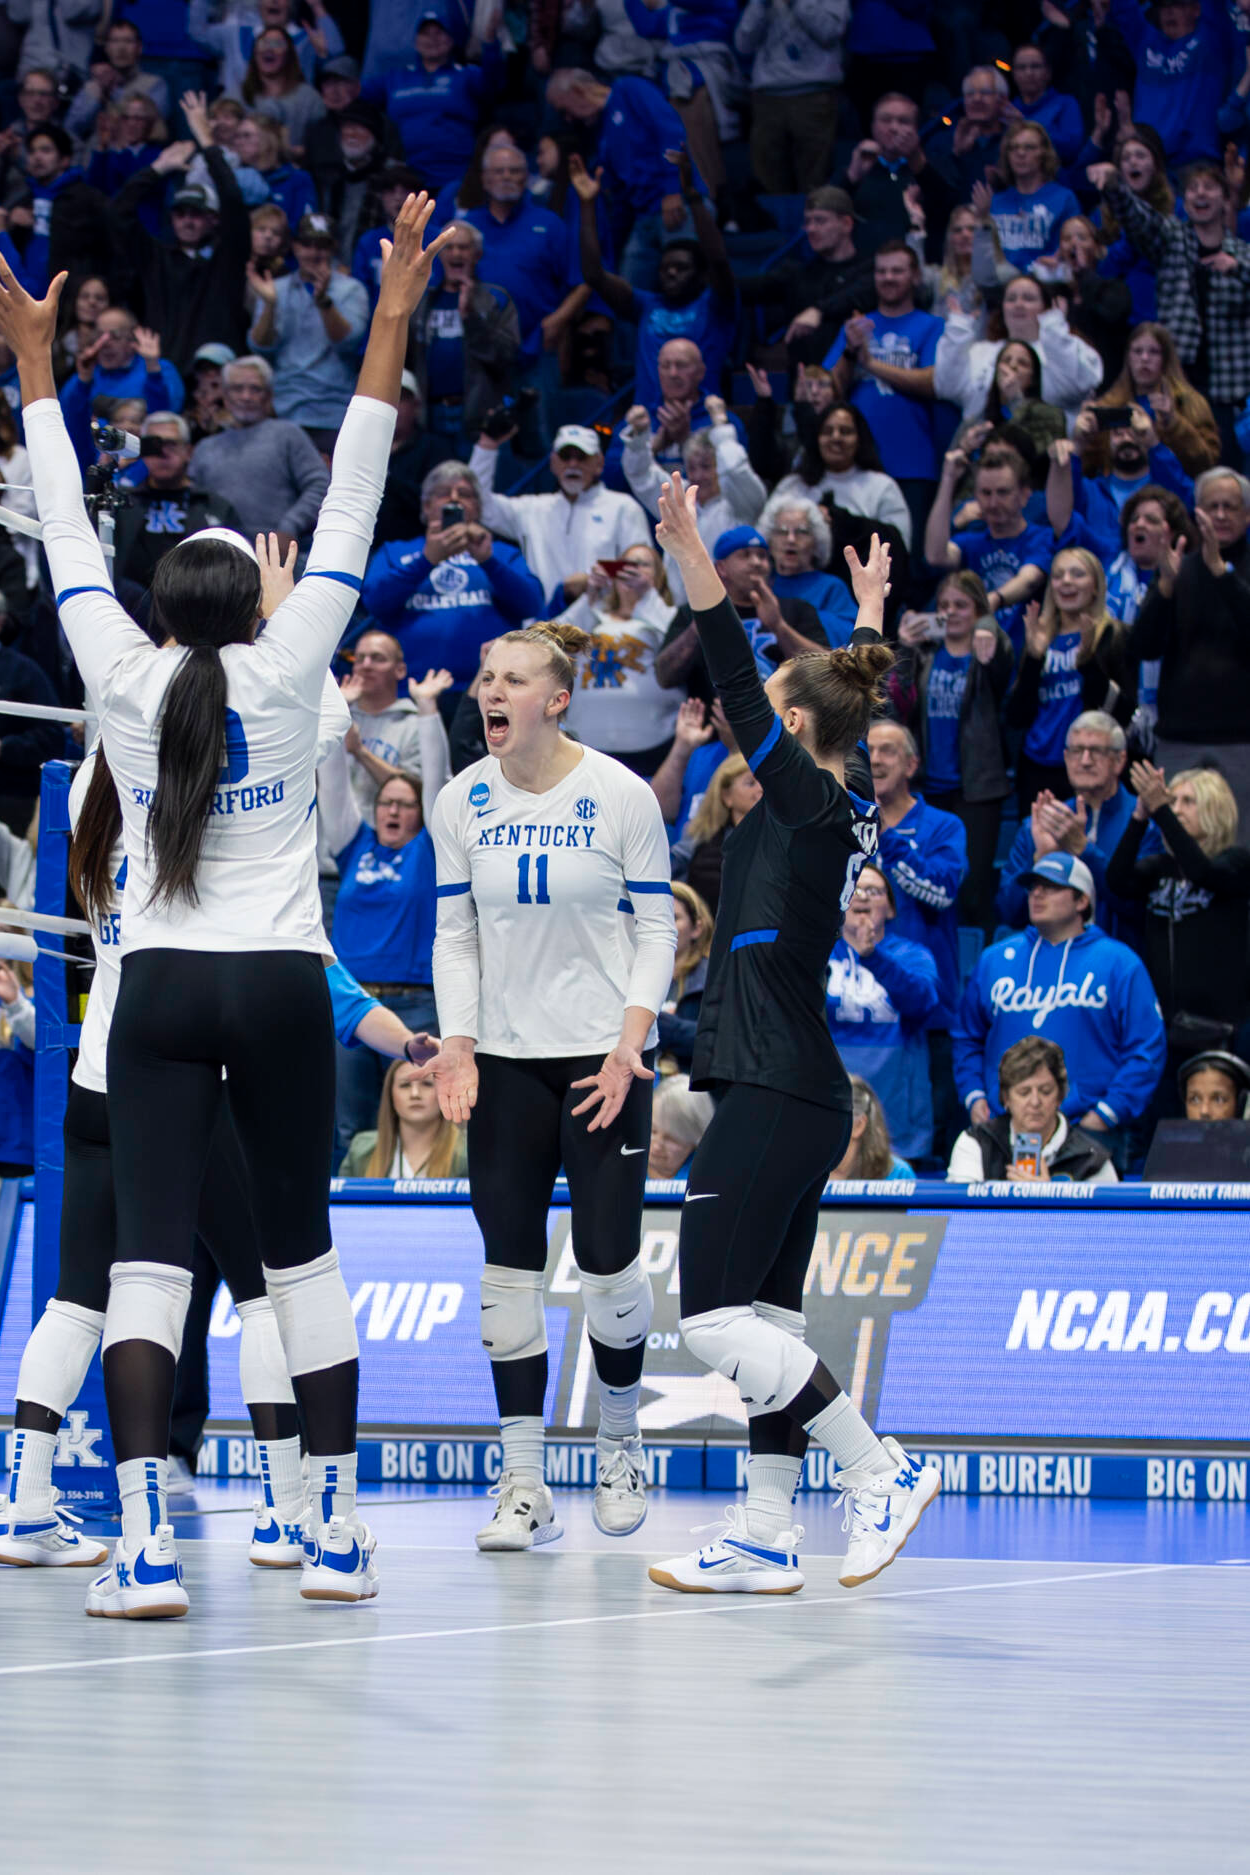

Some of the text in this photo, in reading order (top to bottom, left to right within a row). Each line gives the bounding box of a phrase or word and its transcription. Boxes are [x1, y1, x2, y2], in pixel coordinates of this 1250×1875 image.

[575, 798, 598, 820] SEC
[478, 824, 596, 848] KENTUCKY
[516, 853, 551, 905] 11
[990, 971, 1108, 1029] Royals
[646, 1332, 681, 1350] ON
[380, 1441, 425, 1480] BIG
[436, 1442, 474, 1481] ON
[978, 1455, 1092, 1496] BUREAU
[1146, 1459, 1248, 1501] BIG ON
